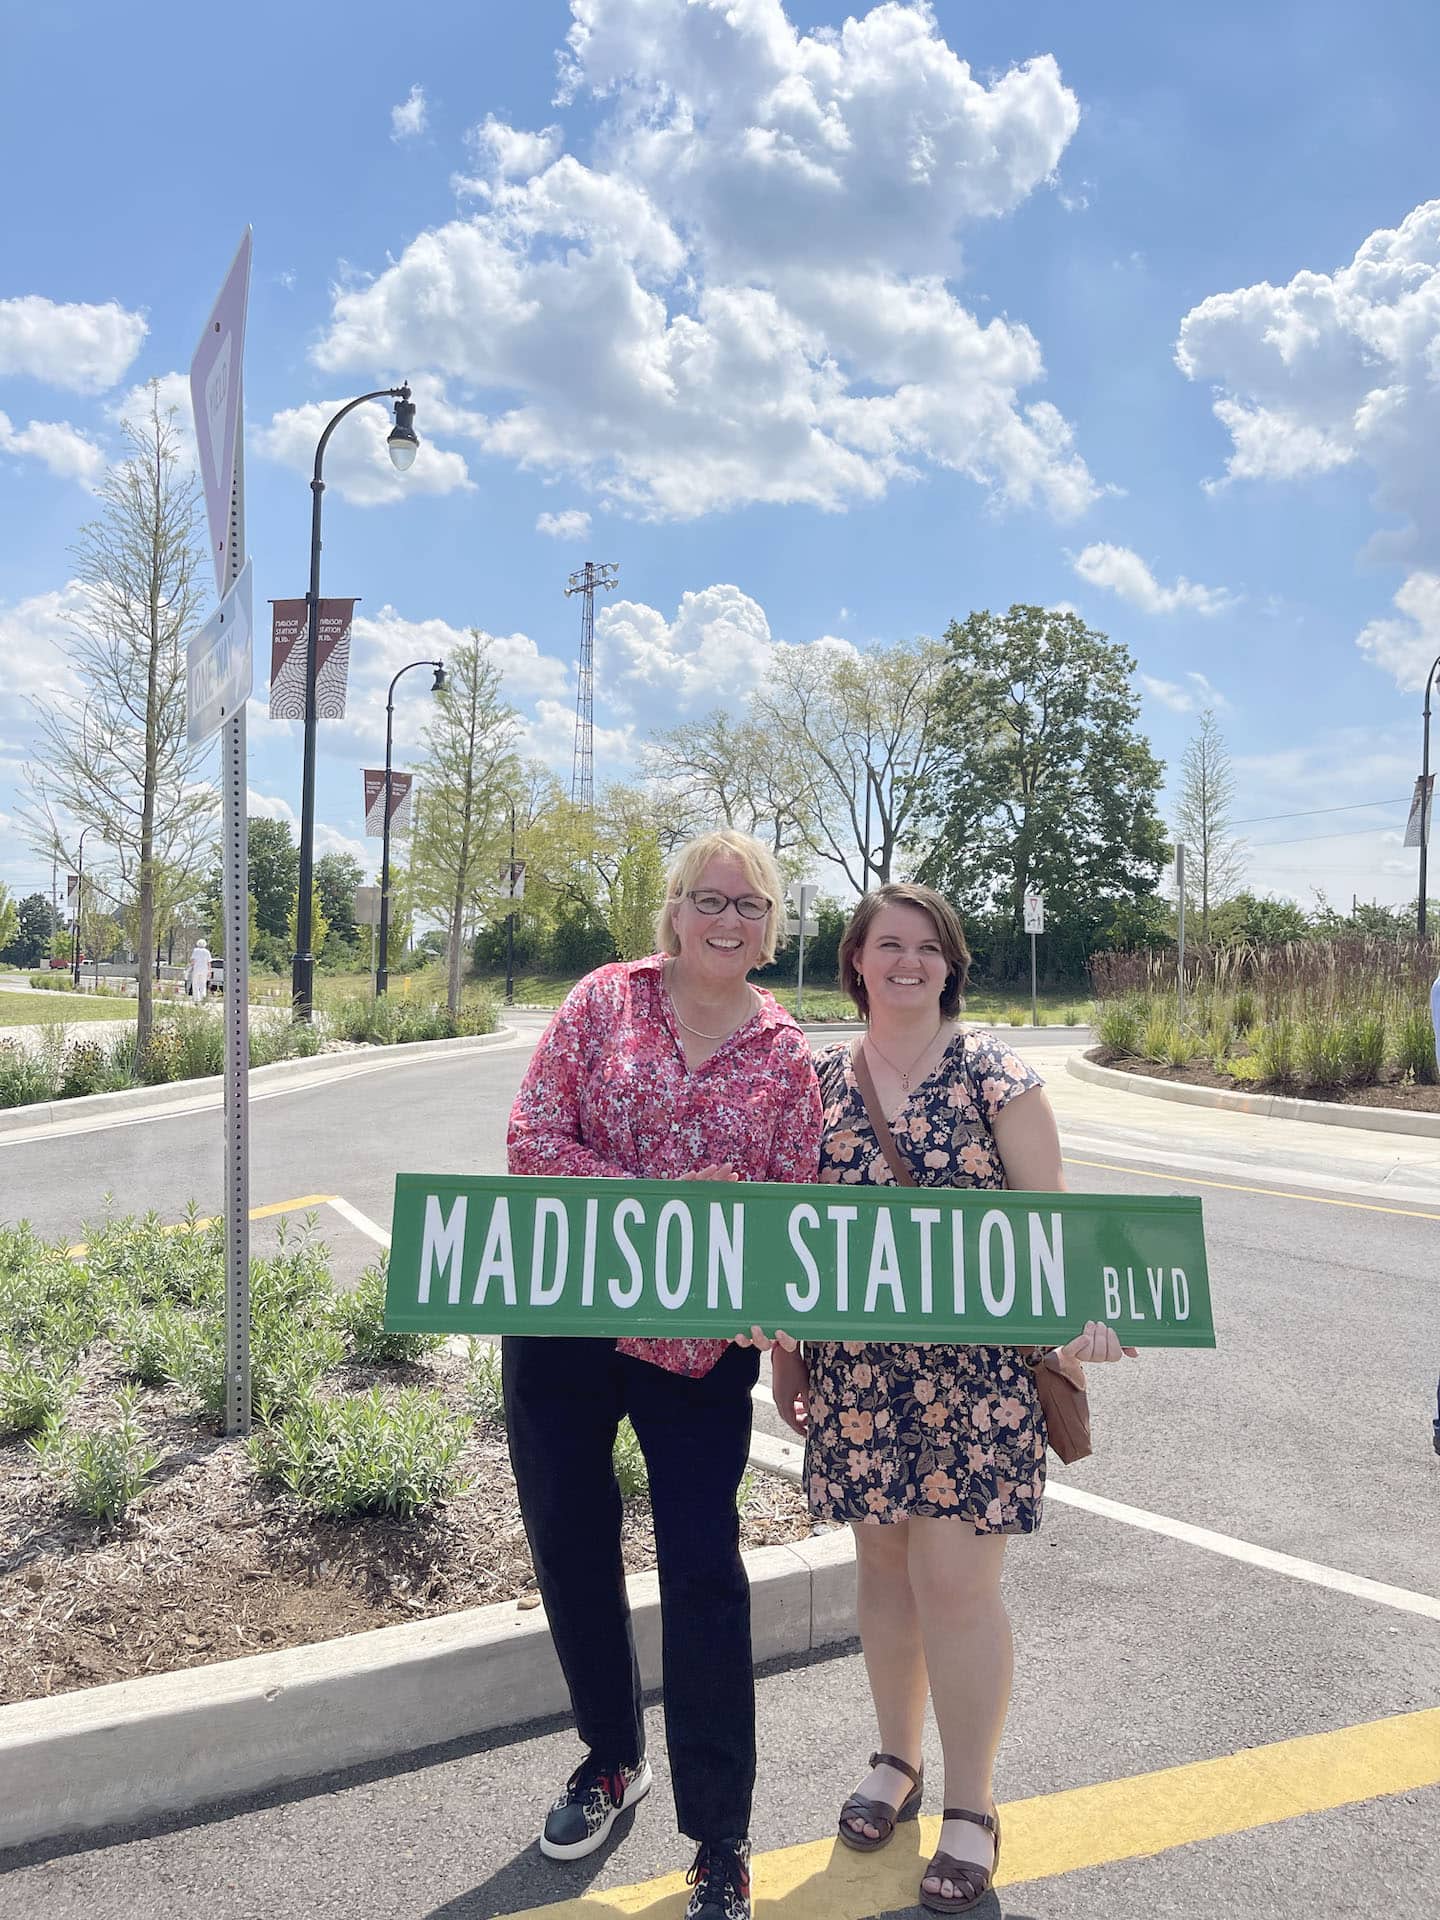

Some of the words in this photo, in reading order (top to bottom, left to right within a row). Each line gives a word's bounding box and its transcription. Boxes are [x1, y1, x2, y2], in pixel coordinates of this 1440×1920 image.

[417, 1195, 744, 1310] MADISON
[785, 1203, 1067, 1318] STATION
[1103, 1266, 1191, 1321] BLVD
